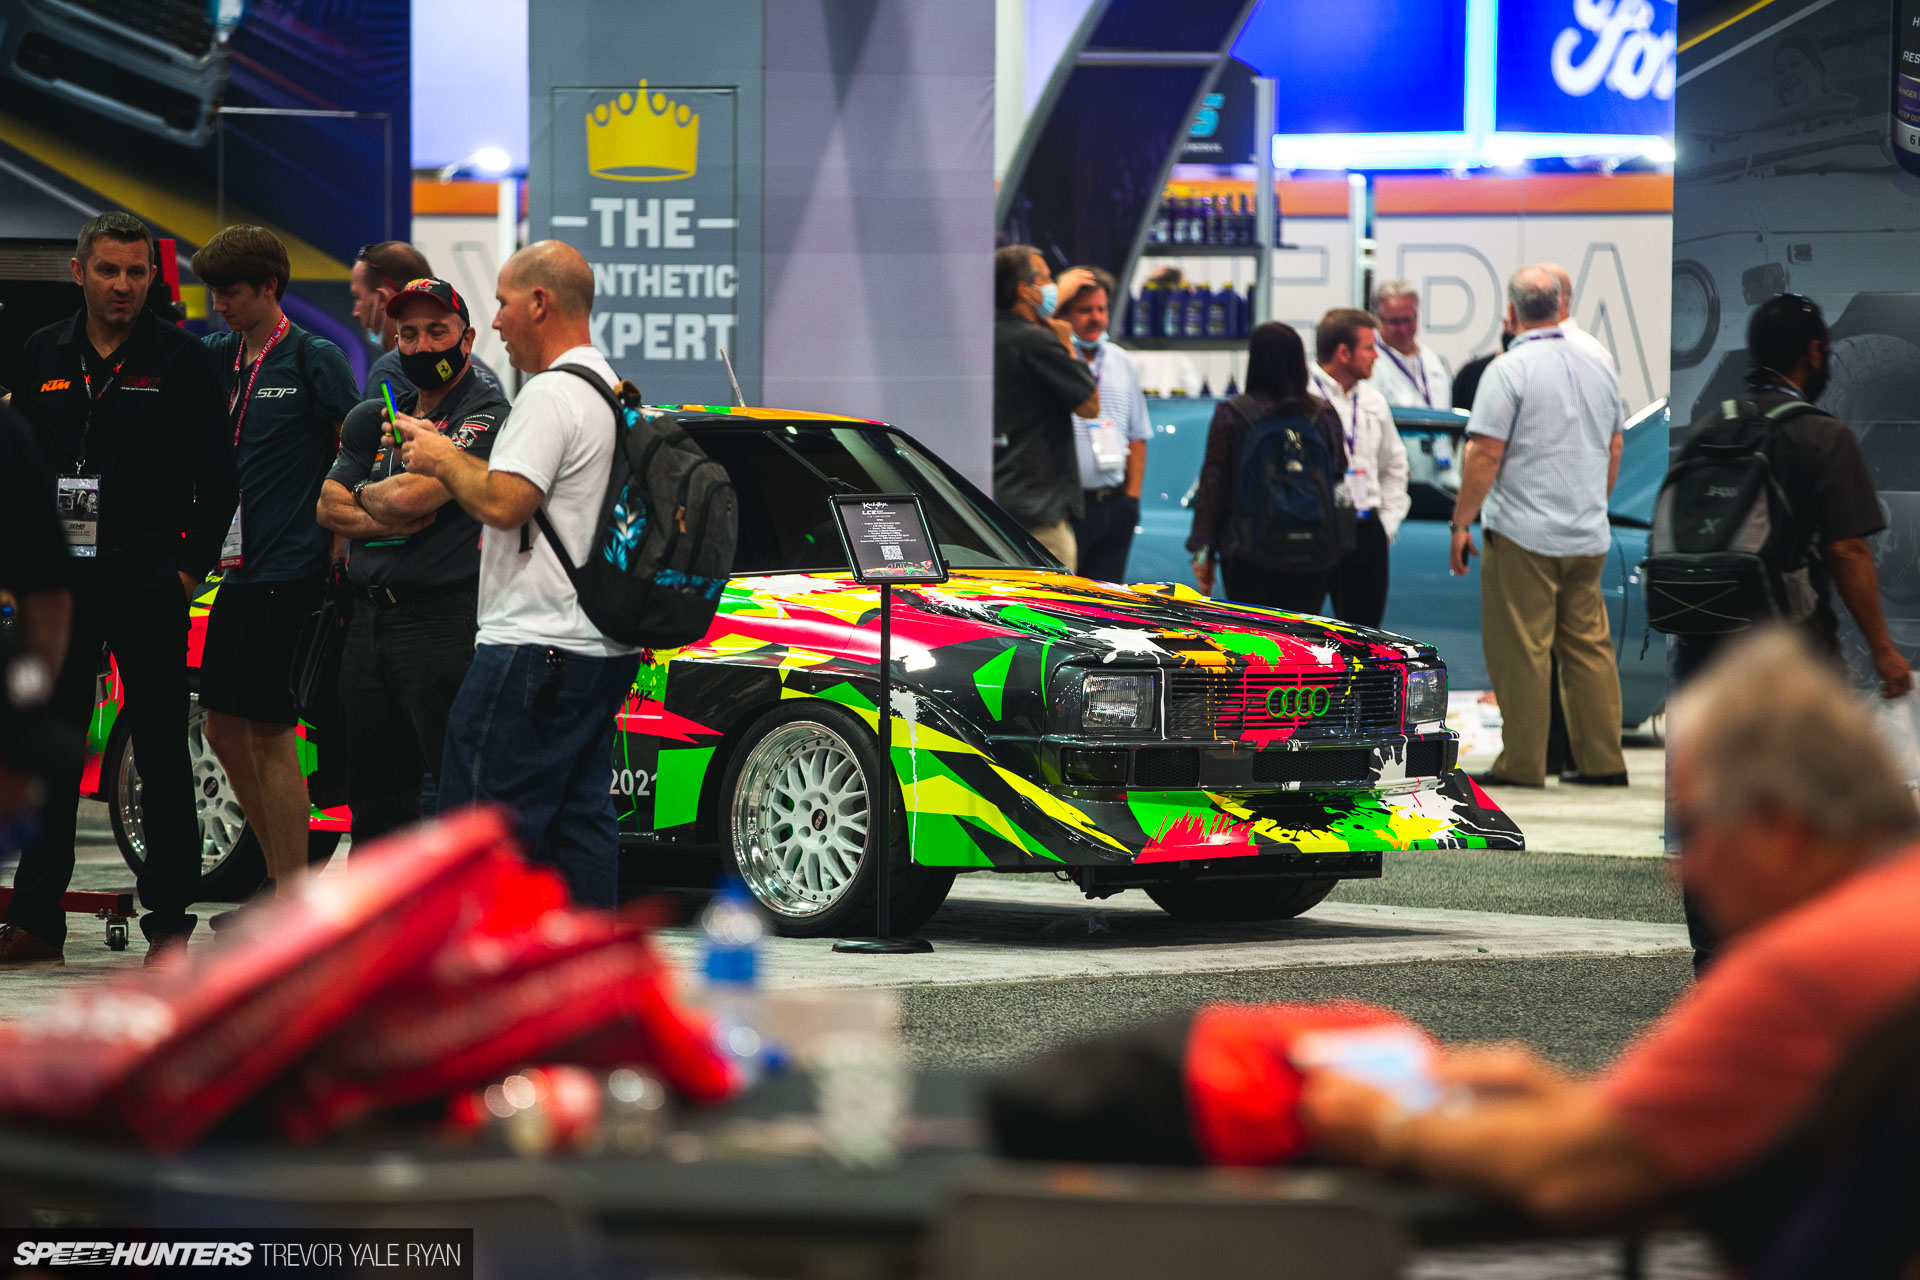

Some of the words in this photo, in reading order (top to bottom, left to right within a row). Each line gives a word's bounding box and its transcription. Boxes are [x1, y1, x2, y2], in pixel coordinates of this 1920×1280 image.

[590, 197, 695, 248] THE
[588, 263, 739, 298] NTHETIC
[589, 312, 739, 361] XPERT
[40, 378, 72, 393] KTM
[609, 769, 658, 796] 202
